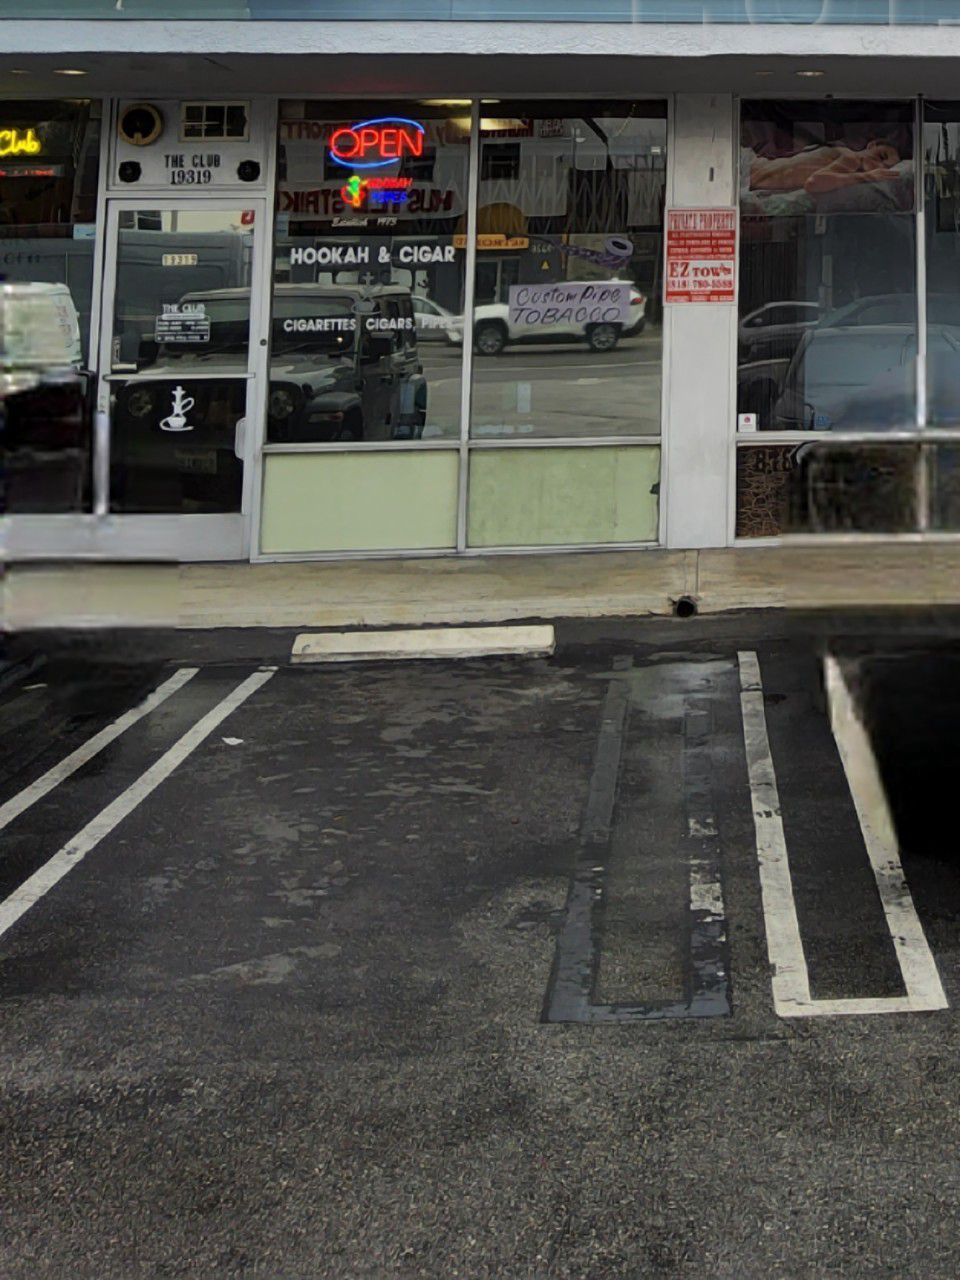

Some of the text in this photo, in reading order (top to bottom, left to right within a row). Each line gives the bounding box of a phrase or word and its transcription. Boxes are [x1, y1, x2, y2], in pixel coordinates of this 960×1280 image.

[331, 129, 424, 158] OPEN
[164, 154, 221, 169] THE CLUB
[170, 170, 212, 185] 19319
[290, 246, 455, 265] HOOKAH & CIGAR
[670, 262, 690, 277] EZ
[516, 285, 577, 305] Custom
[513, 306, 621, 324] TOBACCO
[283, 319, 356, 332] CIGARETTES
